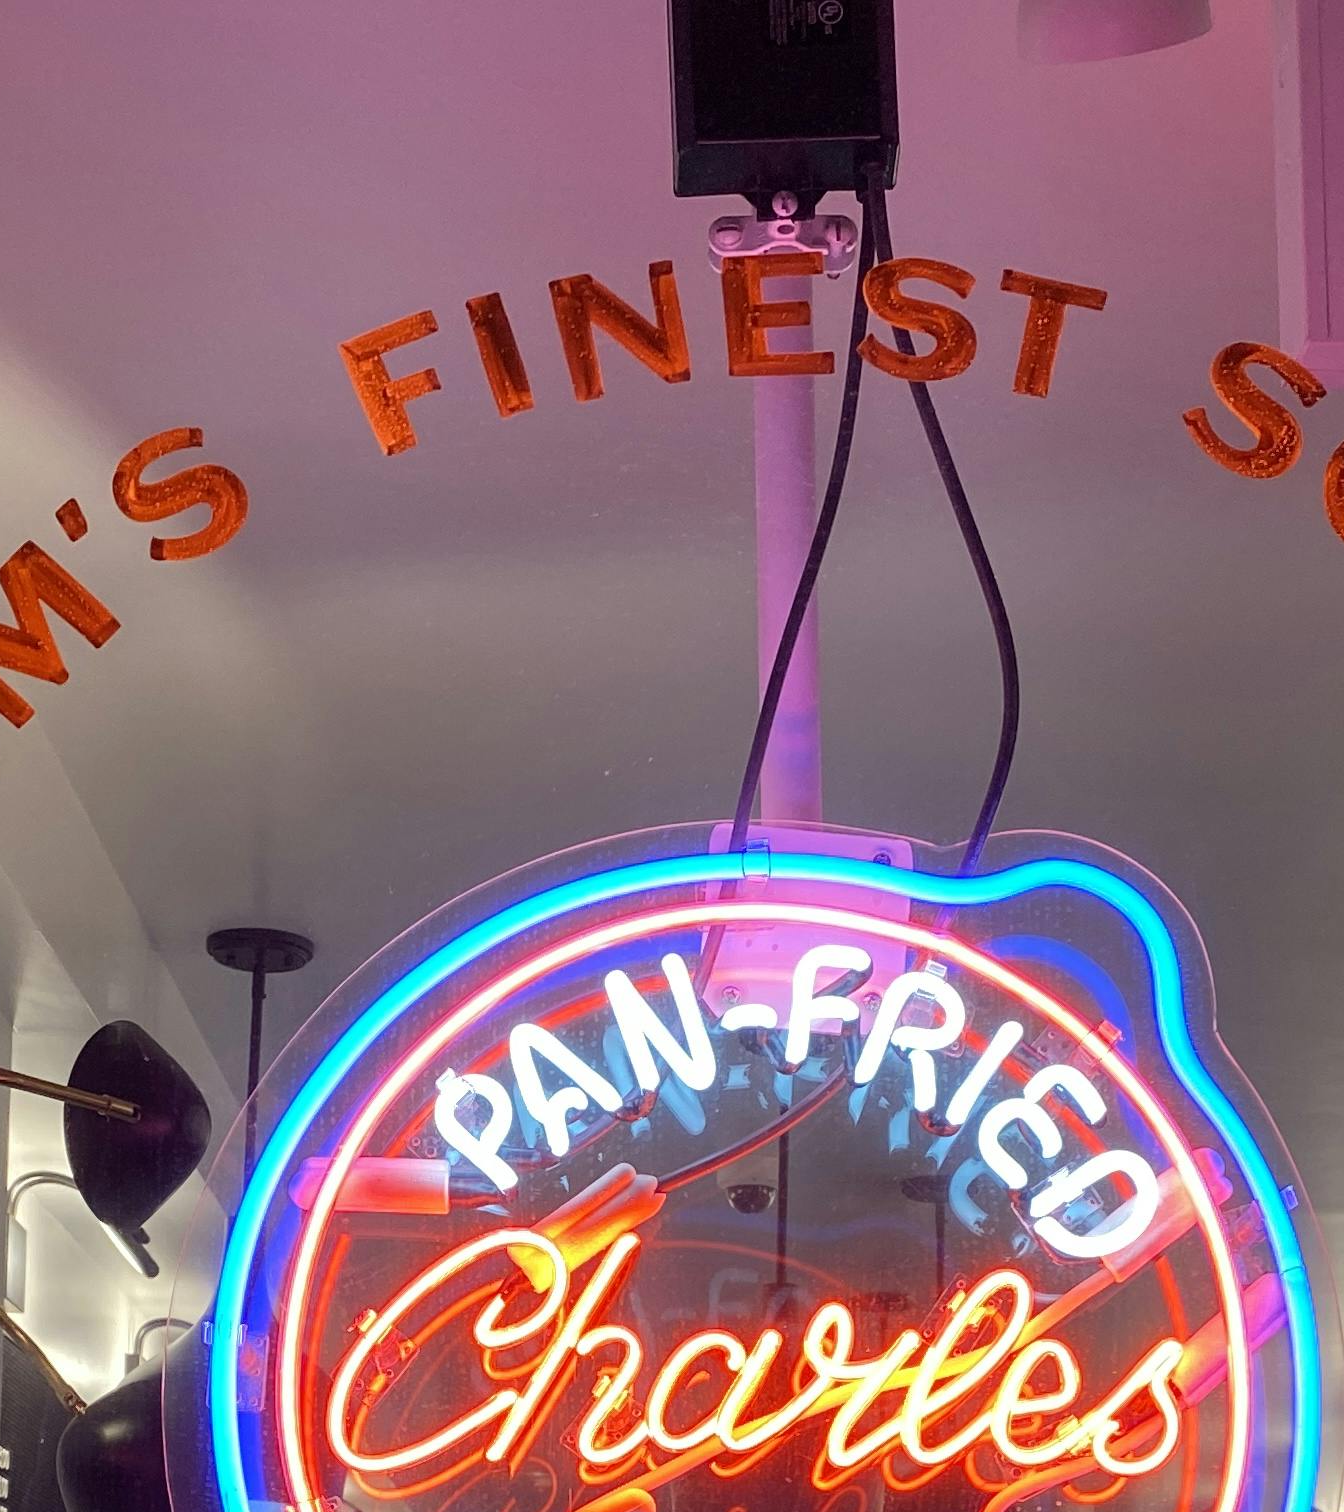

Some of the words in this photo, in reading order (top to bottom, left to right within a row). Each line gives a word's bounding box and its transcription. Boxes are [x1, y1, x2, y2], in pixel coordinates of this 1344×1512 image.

[341, 252, 1109, 457] FINEST
[432, 942, 1165, 1260] PAN-FRIED
[329, 1229, 1185, 1475] Charles
